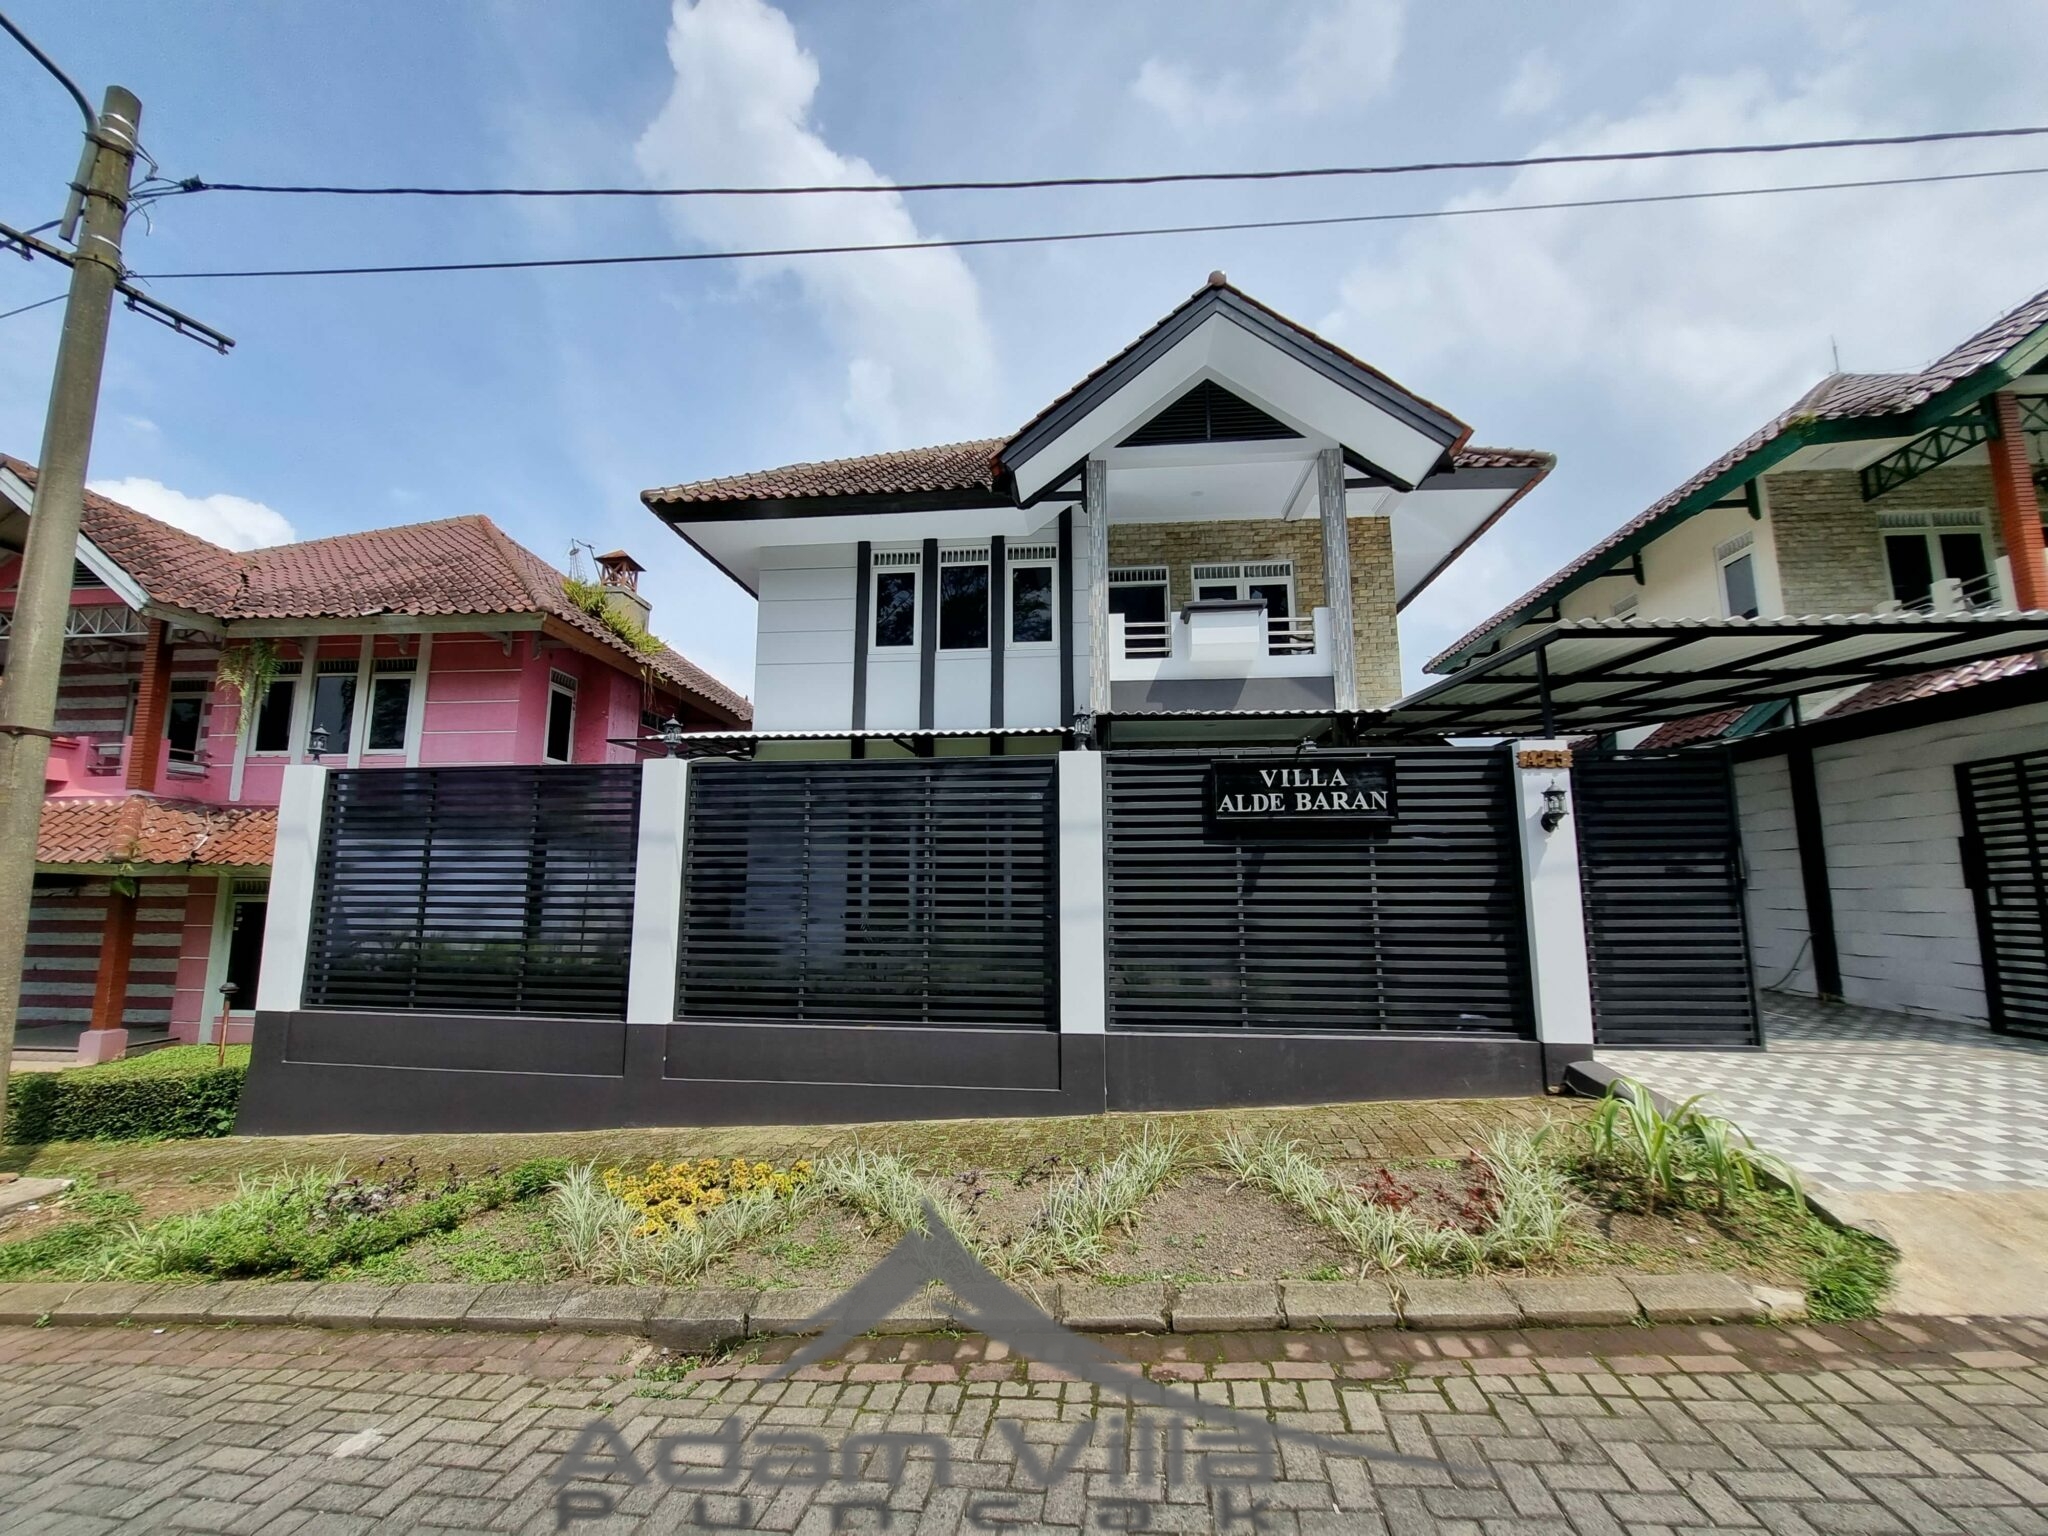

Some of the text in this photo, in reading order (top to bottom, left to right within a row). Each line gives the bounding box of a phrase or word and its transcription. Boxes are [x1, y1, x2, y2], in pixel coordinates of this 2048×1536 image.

[1259, 768, 1349, 788] VILLA
[1217, 791, 1389, 813] ALDE BARAN
